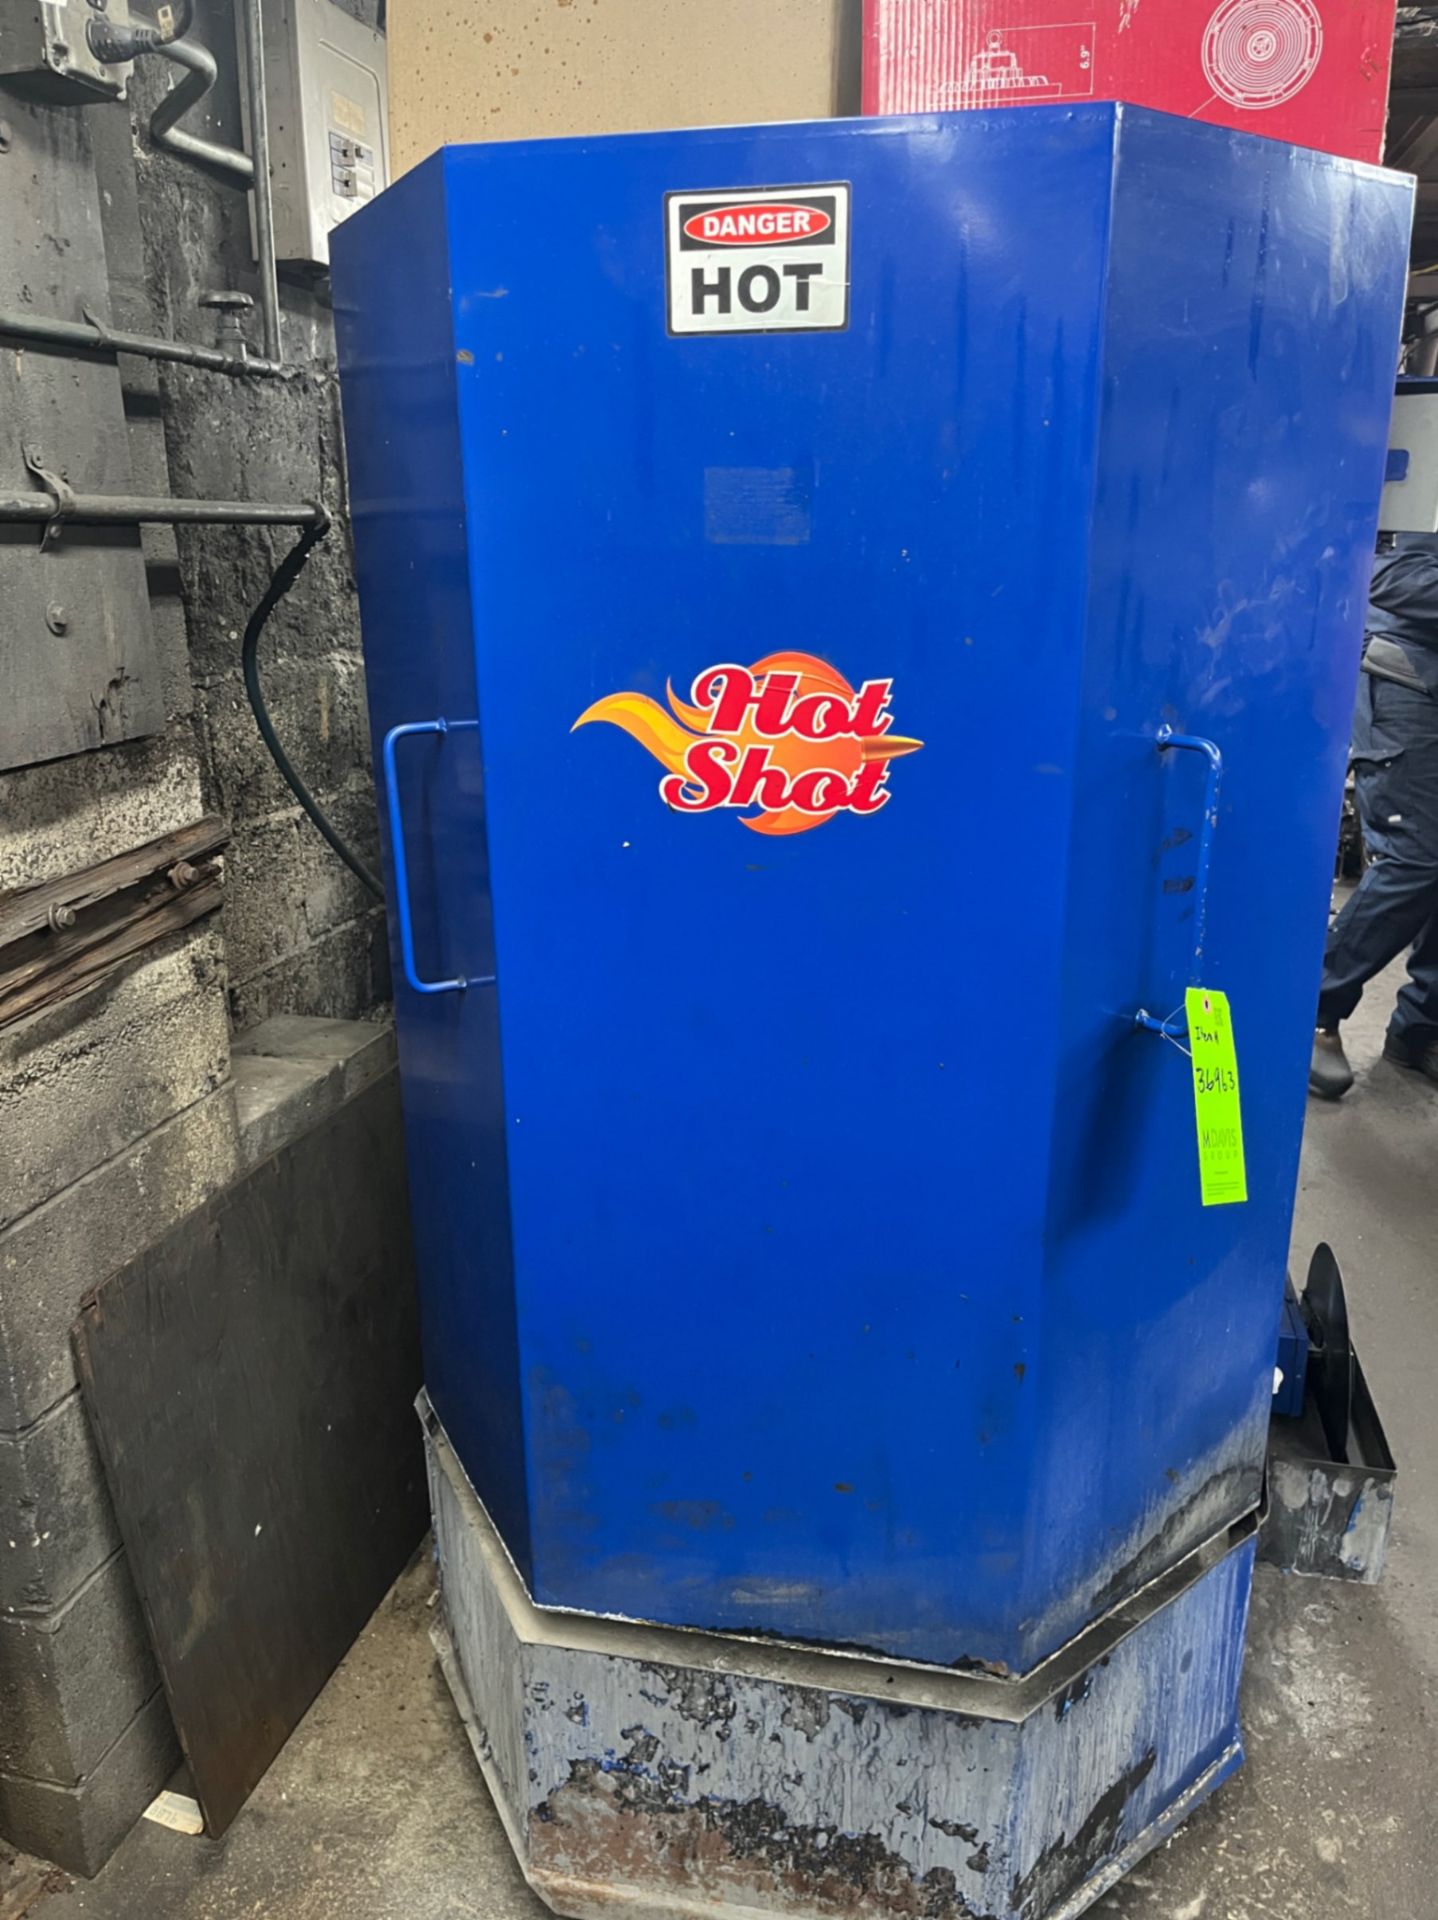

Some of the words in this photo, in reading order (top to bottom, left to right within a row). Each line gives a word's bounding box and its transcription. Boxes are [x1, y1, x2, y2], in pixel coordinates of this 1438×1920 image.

[703, 210, 811, 237] DANGER
[691, 262, 823, 315] HOT
[691, 663, 894, 742] Hot
[659, 738, 891, 814] Shot
[1195, 1066, 1235, 1094] 36963
